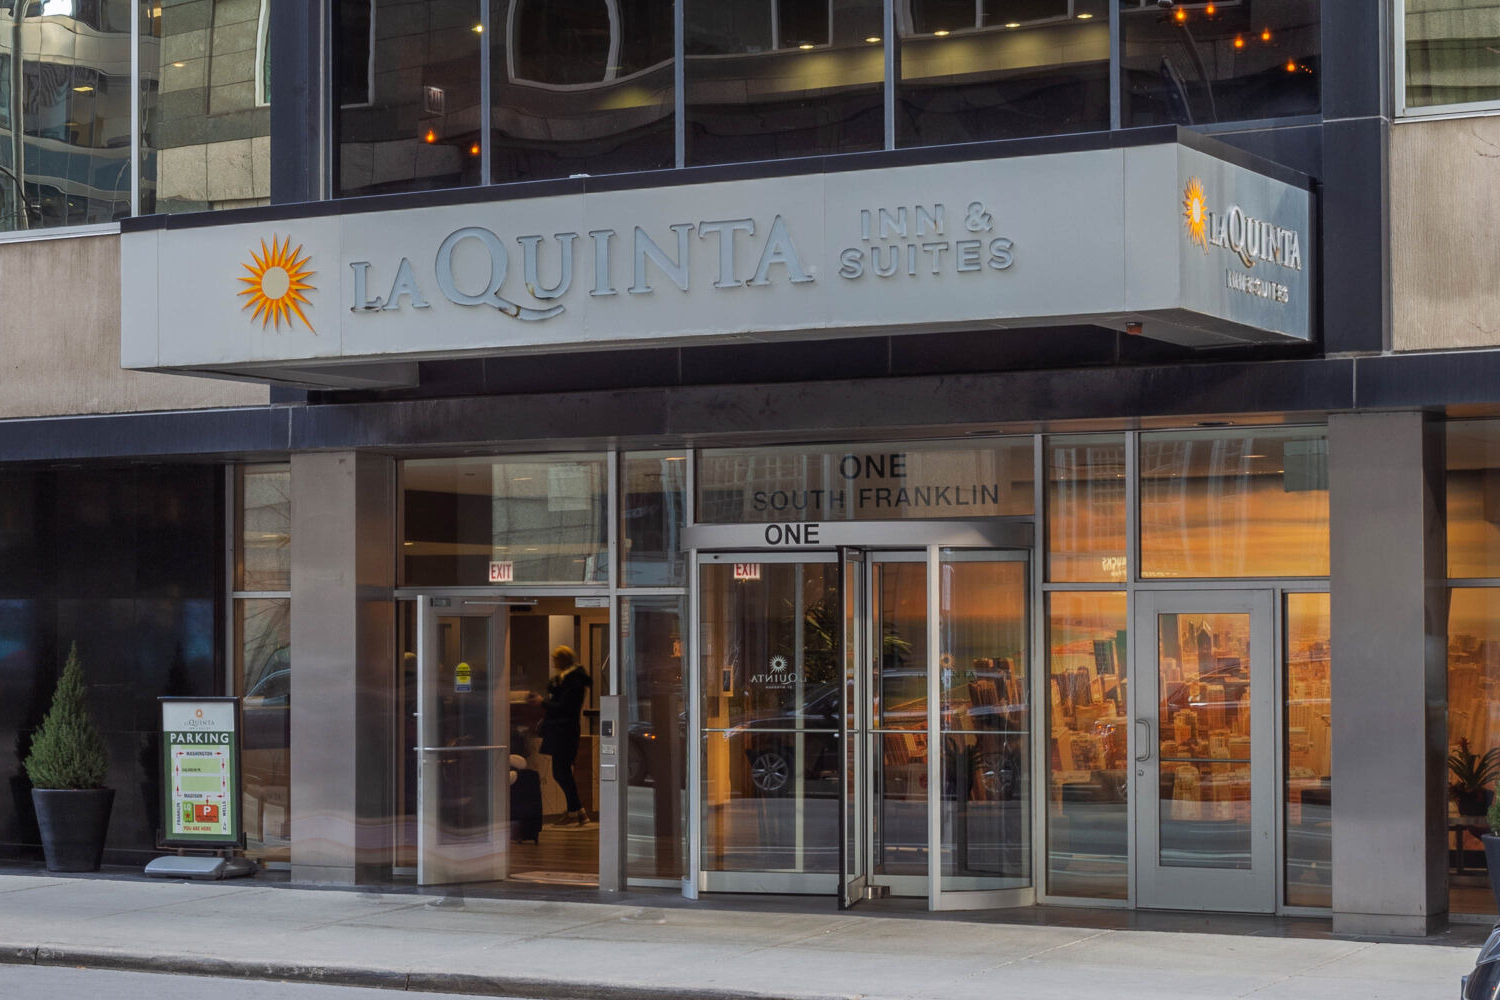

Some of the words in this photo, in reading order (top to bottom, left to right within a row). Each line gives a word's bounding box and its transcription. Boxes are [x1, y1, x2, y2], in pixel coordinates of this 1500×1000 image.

[860, 203, 945, 241] INN
[964, 201, 993, 233] &
[1208, 211, 1229, 249] LA
[1227, 204, 1303, 271] QUINTA
[349, 256, 431, 313] LA
[435, 213, 816, 322] QUINTA
[838, 237, 1015, 280] SUITES
[1225, 268, 1246, 292] INN
[1251, 278, 1289, 304] SUITES
[840, 453, 907, 480] ONE
[753, 489, 845, 512] SOUTH
[859, 484, 1000, 509] FRANKLIN
[764, 523, 821, 546] ONE
[490, 564, 512, 581] EXIT
[735, 563, 758, 577] EXIT
[188, 719, 216, 727] QUINTA
[170, 732, 229, 744] PARKING
[203, 805, 212, 816] P
